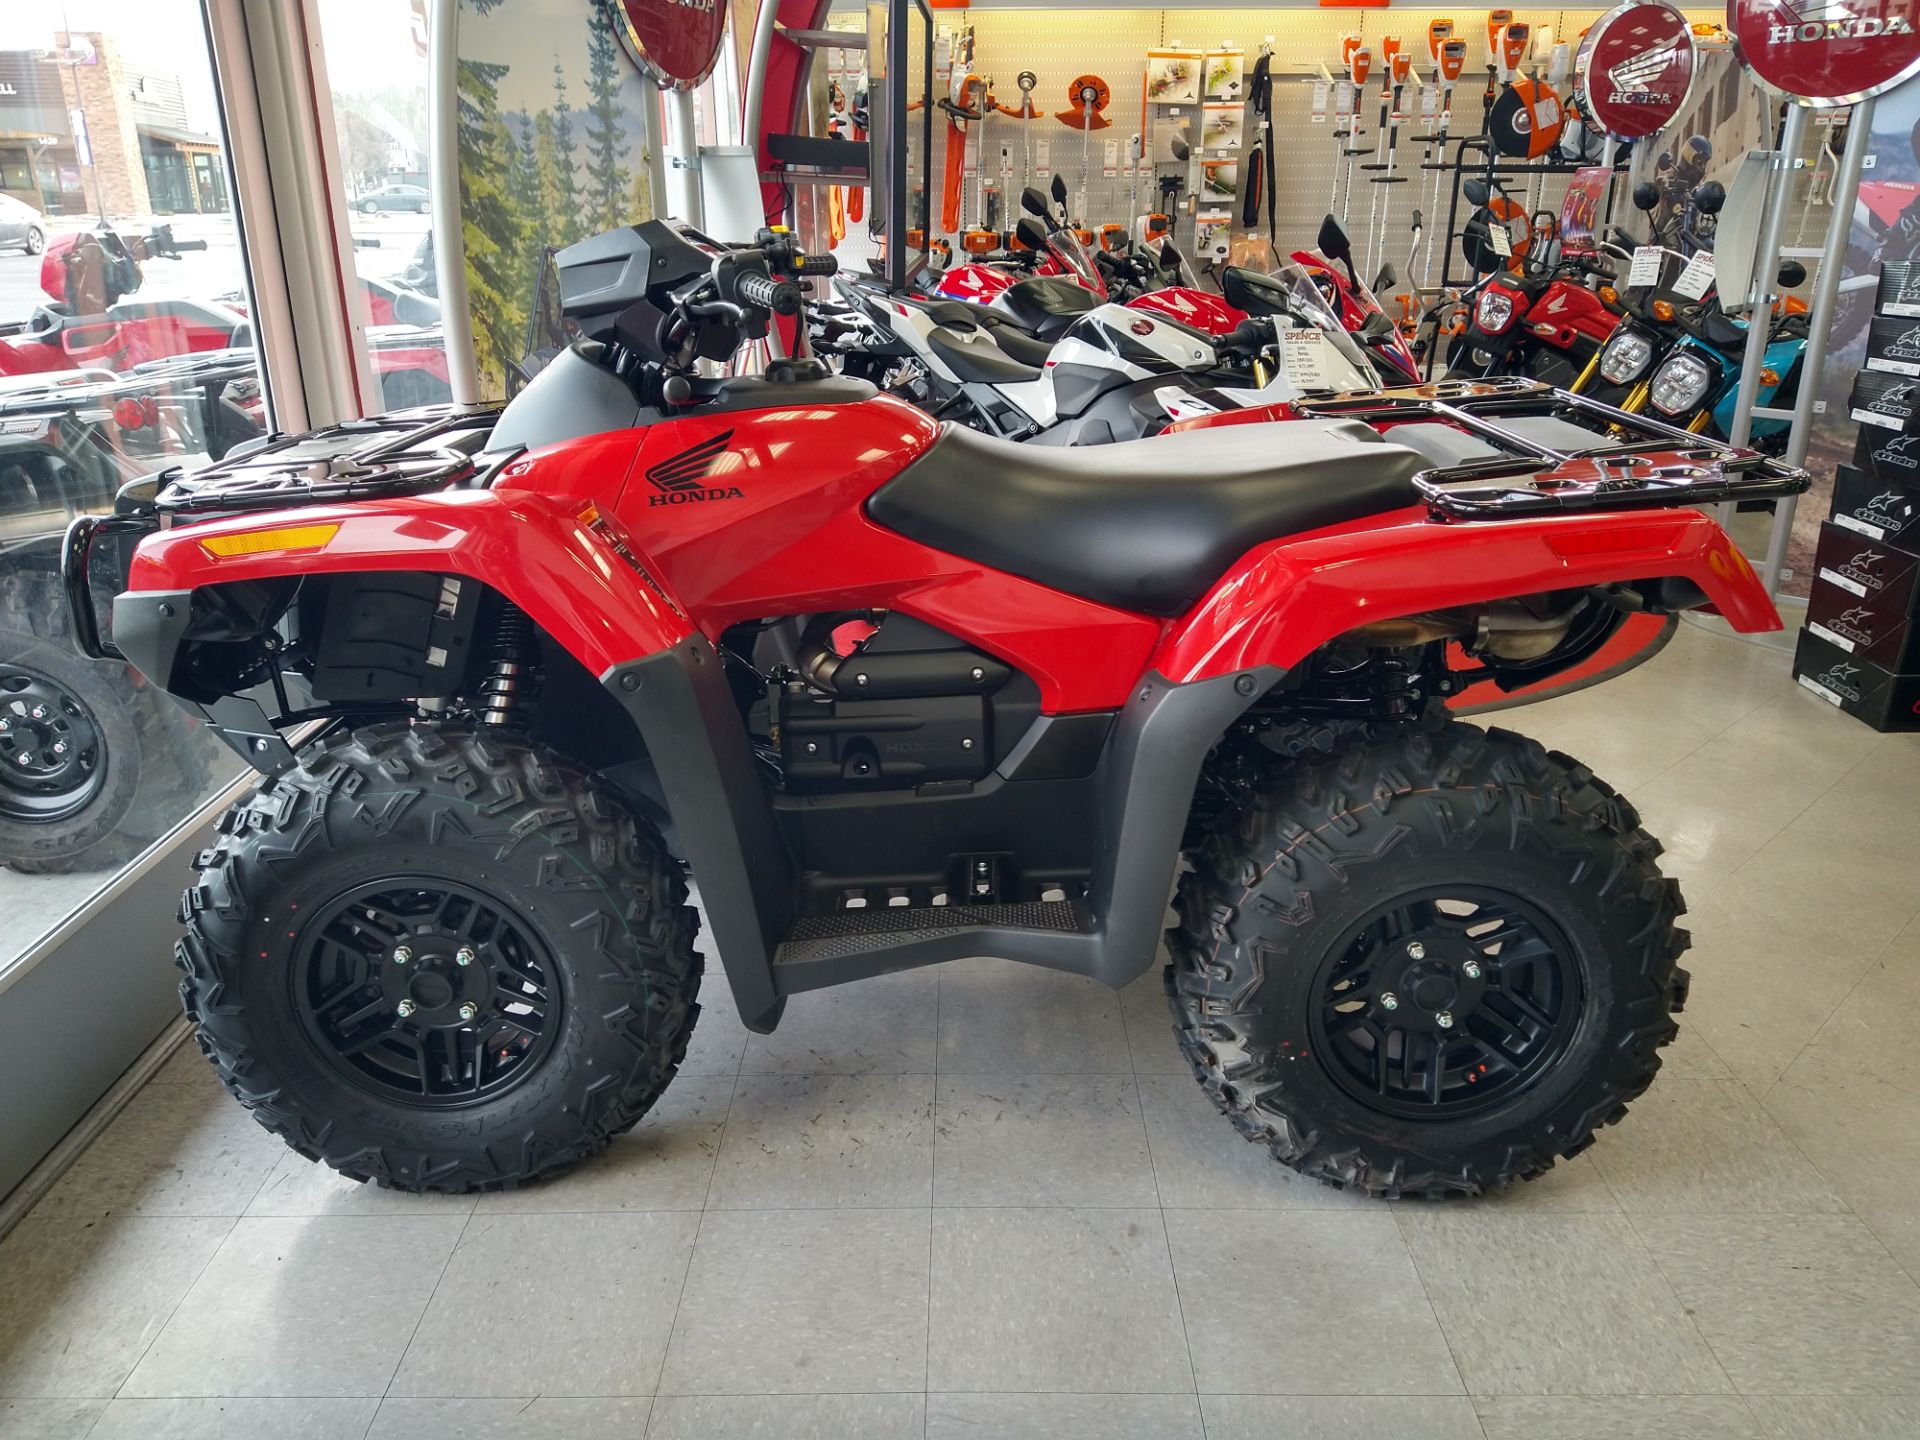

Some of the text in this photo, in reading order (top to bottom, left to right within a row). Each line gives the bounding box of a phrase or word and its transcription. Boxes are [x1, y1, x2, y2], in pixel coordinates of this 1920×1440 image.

[1768, 16, 1915, 44] HONDA
[1608, 91, 1673, 104] HONDA
[1284, 332, 1321, 341] SPENCE
[1867, 400, 1912, 417] alpinestars
[1873, 449, 1918, 468] alpinestars
[648, 487, 745, 507] HONDA
[1853, 507, 1901, 531] alpinestars
[1838, 564, 1883, 590] alpinestars
[1827, 619, 1872, 646] alpinestars
[1818, 673, 1860, 702] alpinestars
